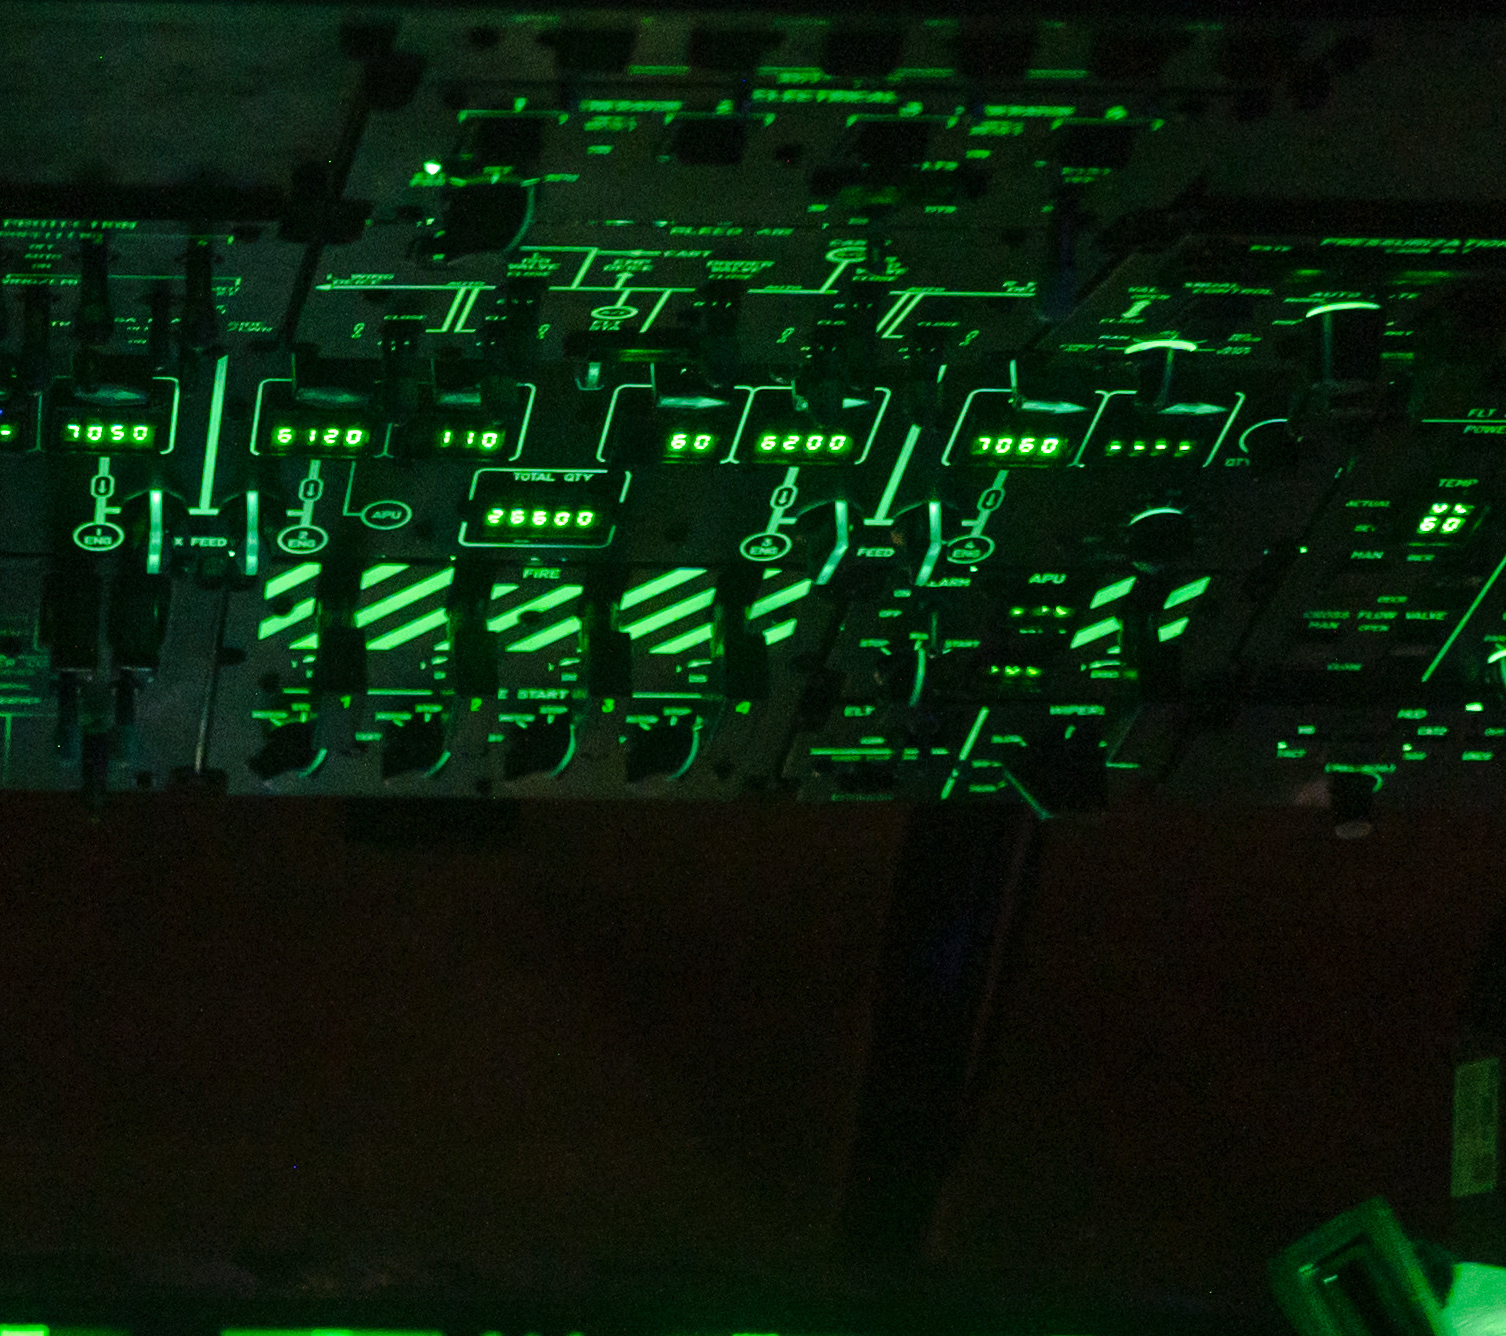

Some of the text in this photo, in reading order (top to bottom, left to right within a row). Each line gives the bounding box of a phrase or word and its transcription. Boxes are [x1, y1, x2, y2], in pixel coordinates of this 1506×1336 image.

[1468, 409, 1496, 417] FLT
[67, 424, 151, 443] 7050
[276, 427, 366, 447] 6120
[441, 430, 501, 450] 110
[669, 433, 713, 452] 60
[759, 433, 849, 453] 6200
[976, 435, 1062, 456] 7060
[512, 471, 595, 482] TOTAL QTY
[1439, 479, 1478, 487] TEMP
[486, 508, 595, 528] 26600
[83, 536, 114, 546] ENG
[190, 537, 227, 547] FEED
[857, 547, 895, 557] FEED
[523, 568, 561, 579] FIRE
[1029, 573, 1066, 584] APU
[471, 698, 482, 711] 2
